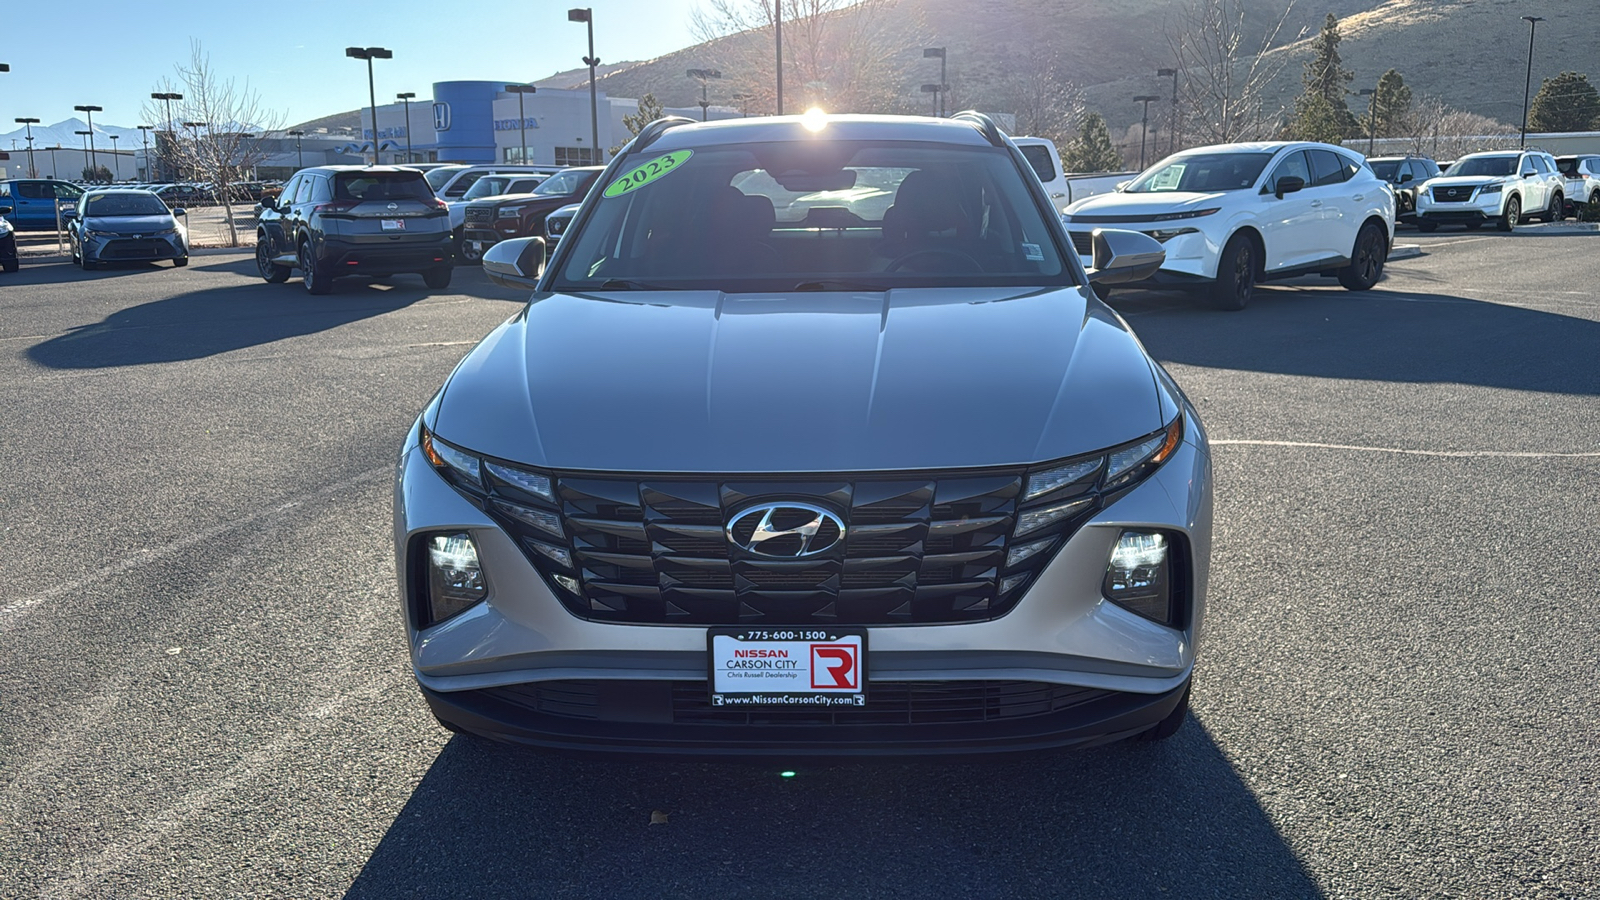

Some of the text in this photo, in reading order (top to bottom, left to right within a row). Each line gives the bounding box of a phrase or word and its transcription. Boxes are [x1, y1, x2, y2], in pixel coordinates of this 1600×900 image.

[494, 117, 539, 131] HONDA
[618, 155, 676, 192] 2023
[748, 631, 826, 640] 775-600-1500
[734, 649, 789, 658] NISSAN
[726, 660, 798, 669] CARSON CITY
[814, 648, 853, 687] R
[765, 672, 798, 680] Dealership
[725, 695, 852, 706] www.NissanCarsonCity.com
